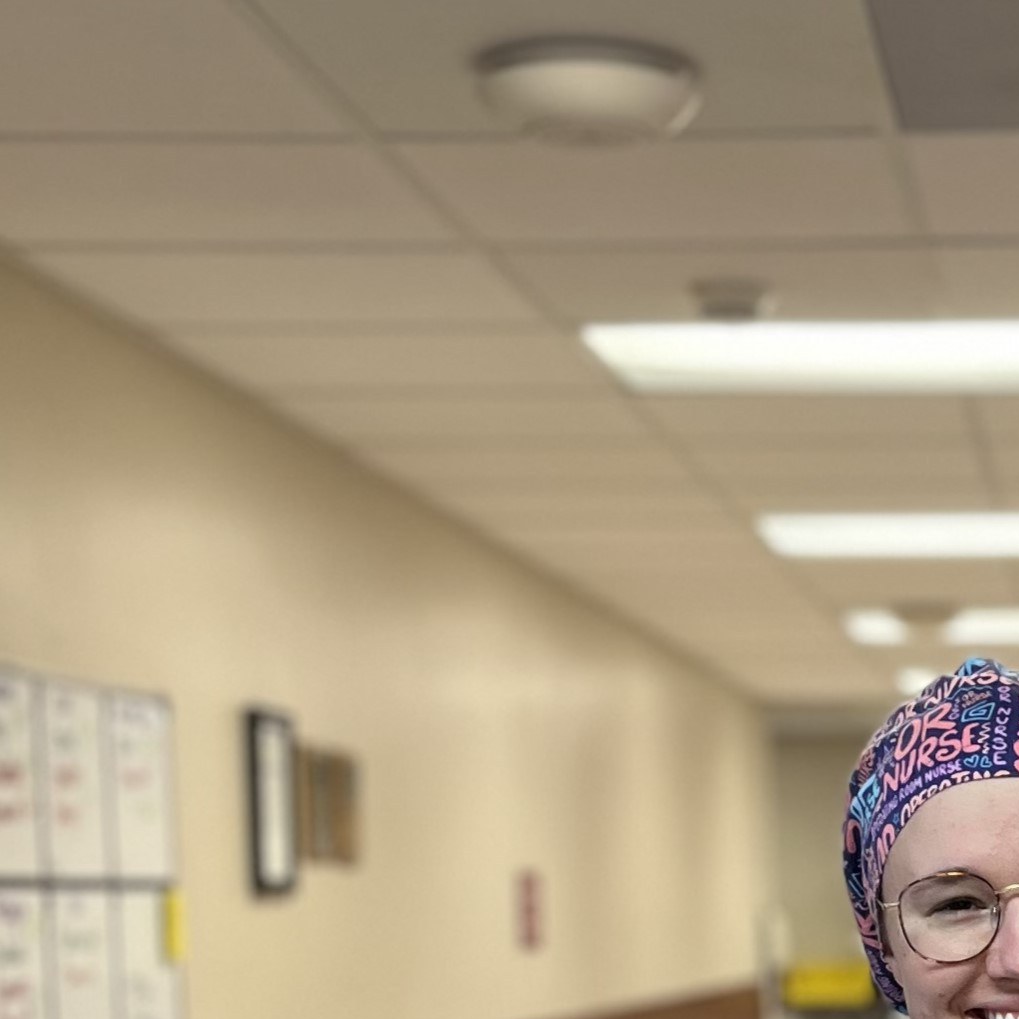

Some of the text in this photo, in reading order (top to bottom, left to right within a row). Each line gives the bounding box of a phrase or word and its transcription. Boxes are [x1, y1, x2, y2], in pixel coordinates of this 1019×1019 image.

[894, 702, 957, 761] OR
[882, 722, 982, 802] NURSE
[924, 758, 963, 783] NURSE
